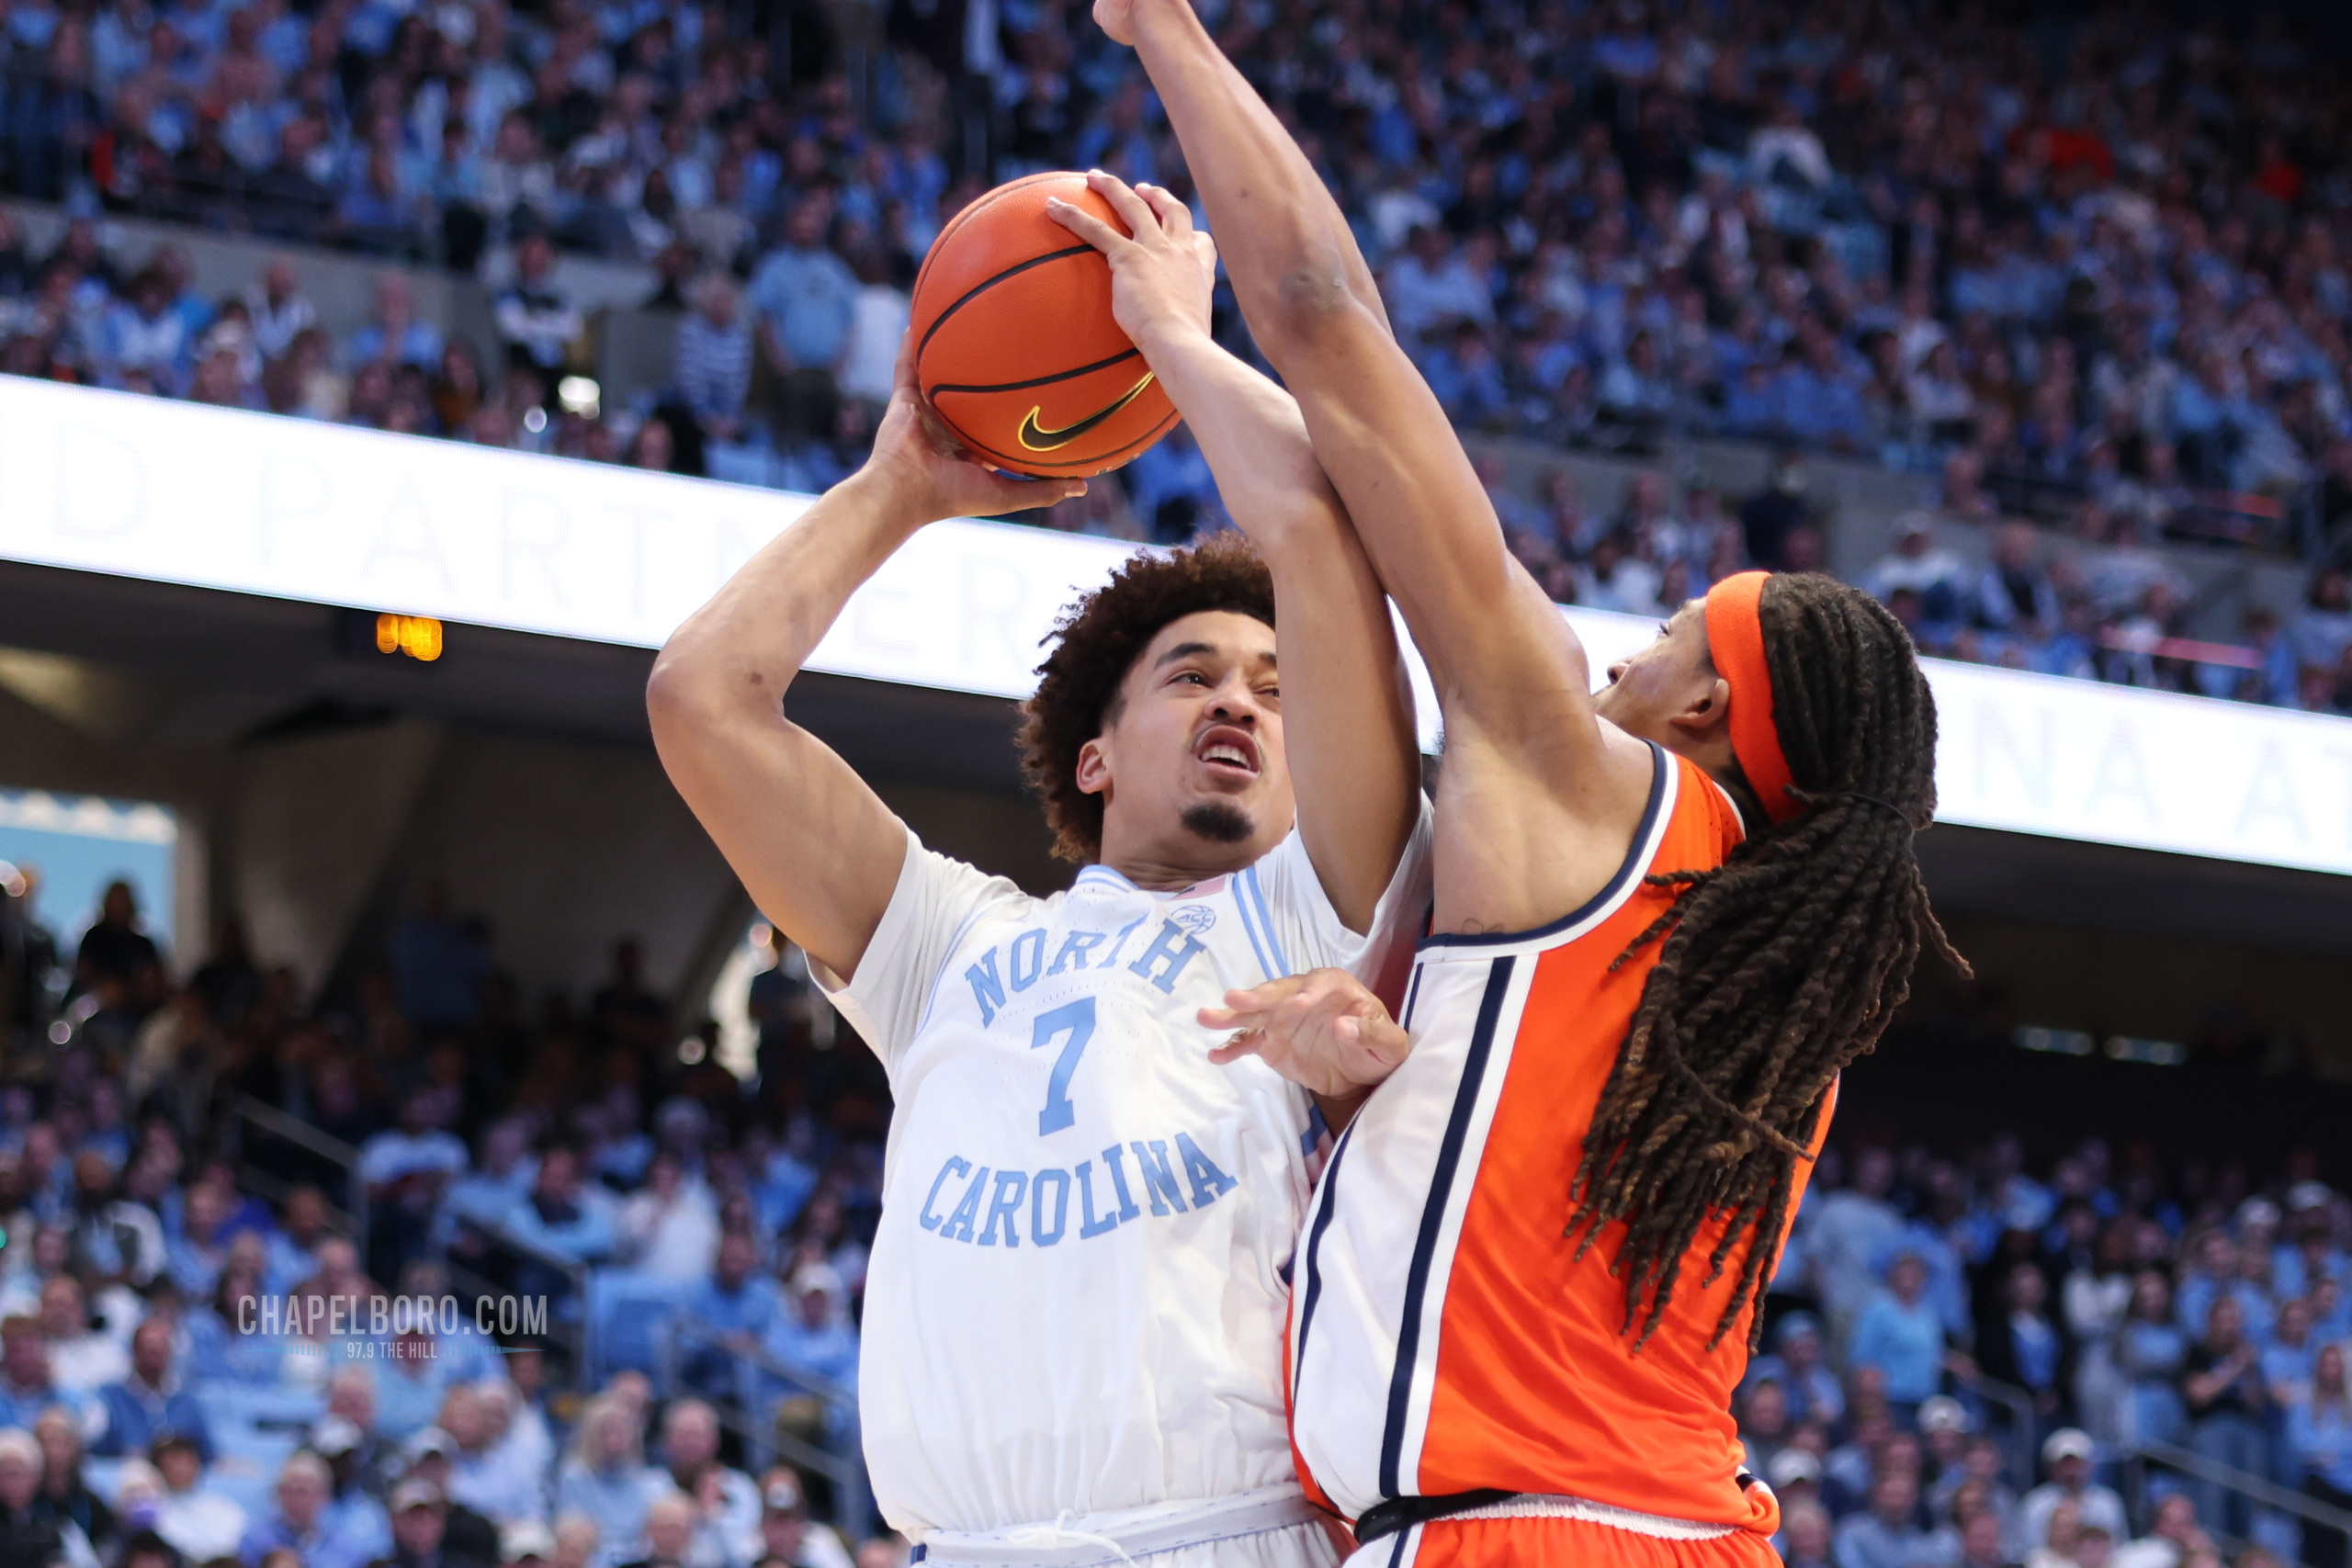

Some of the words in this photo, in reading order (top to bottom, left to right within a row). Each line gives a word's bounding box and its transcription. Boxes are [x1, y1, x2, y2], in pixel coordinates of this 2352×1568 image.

[965, 911, 1206, 1029] NORTH
[1031, 996, 1096, 1137] 7
[920, 1132, 1238, 1247] CAROLINA
